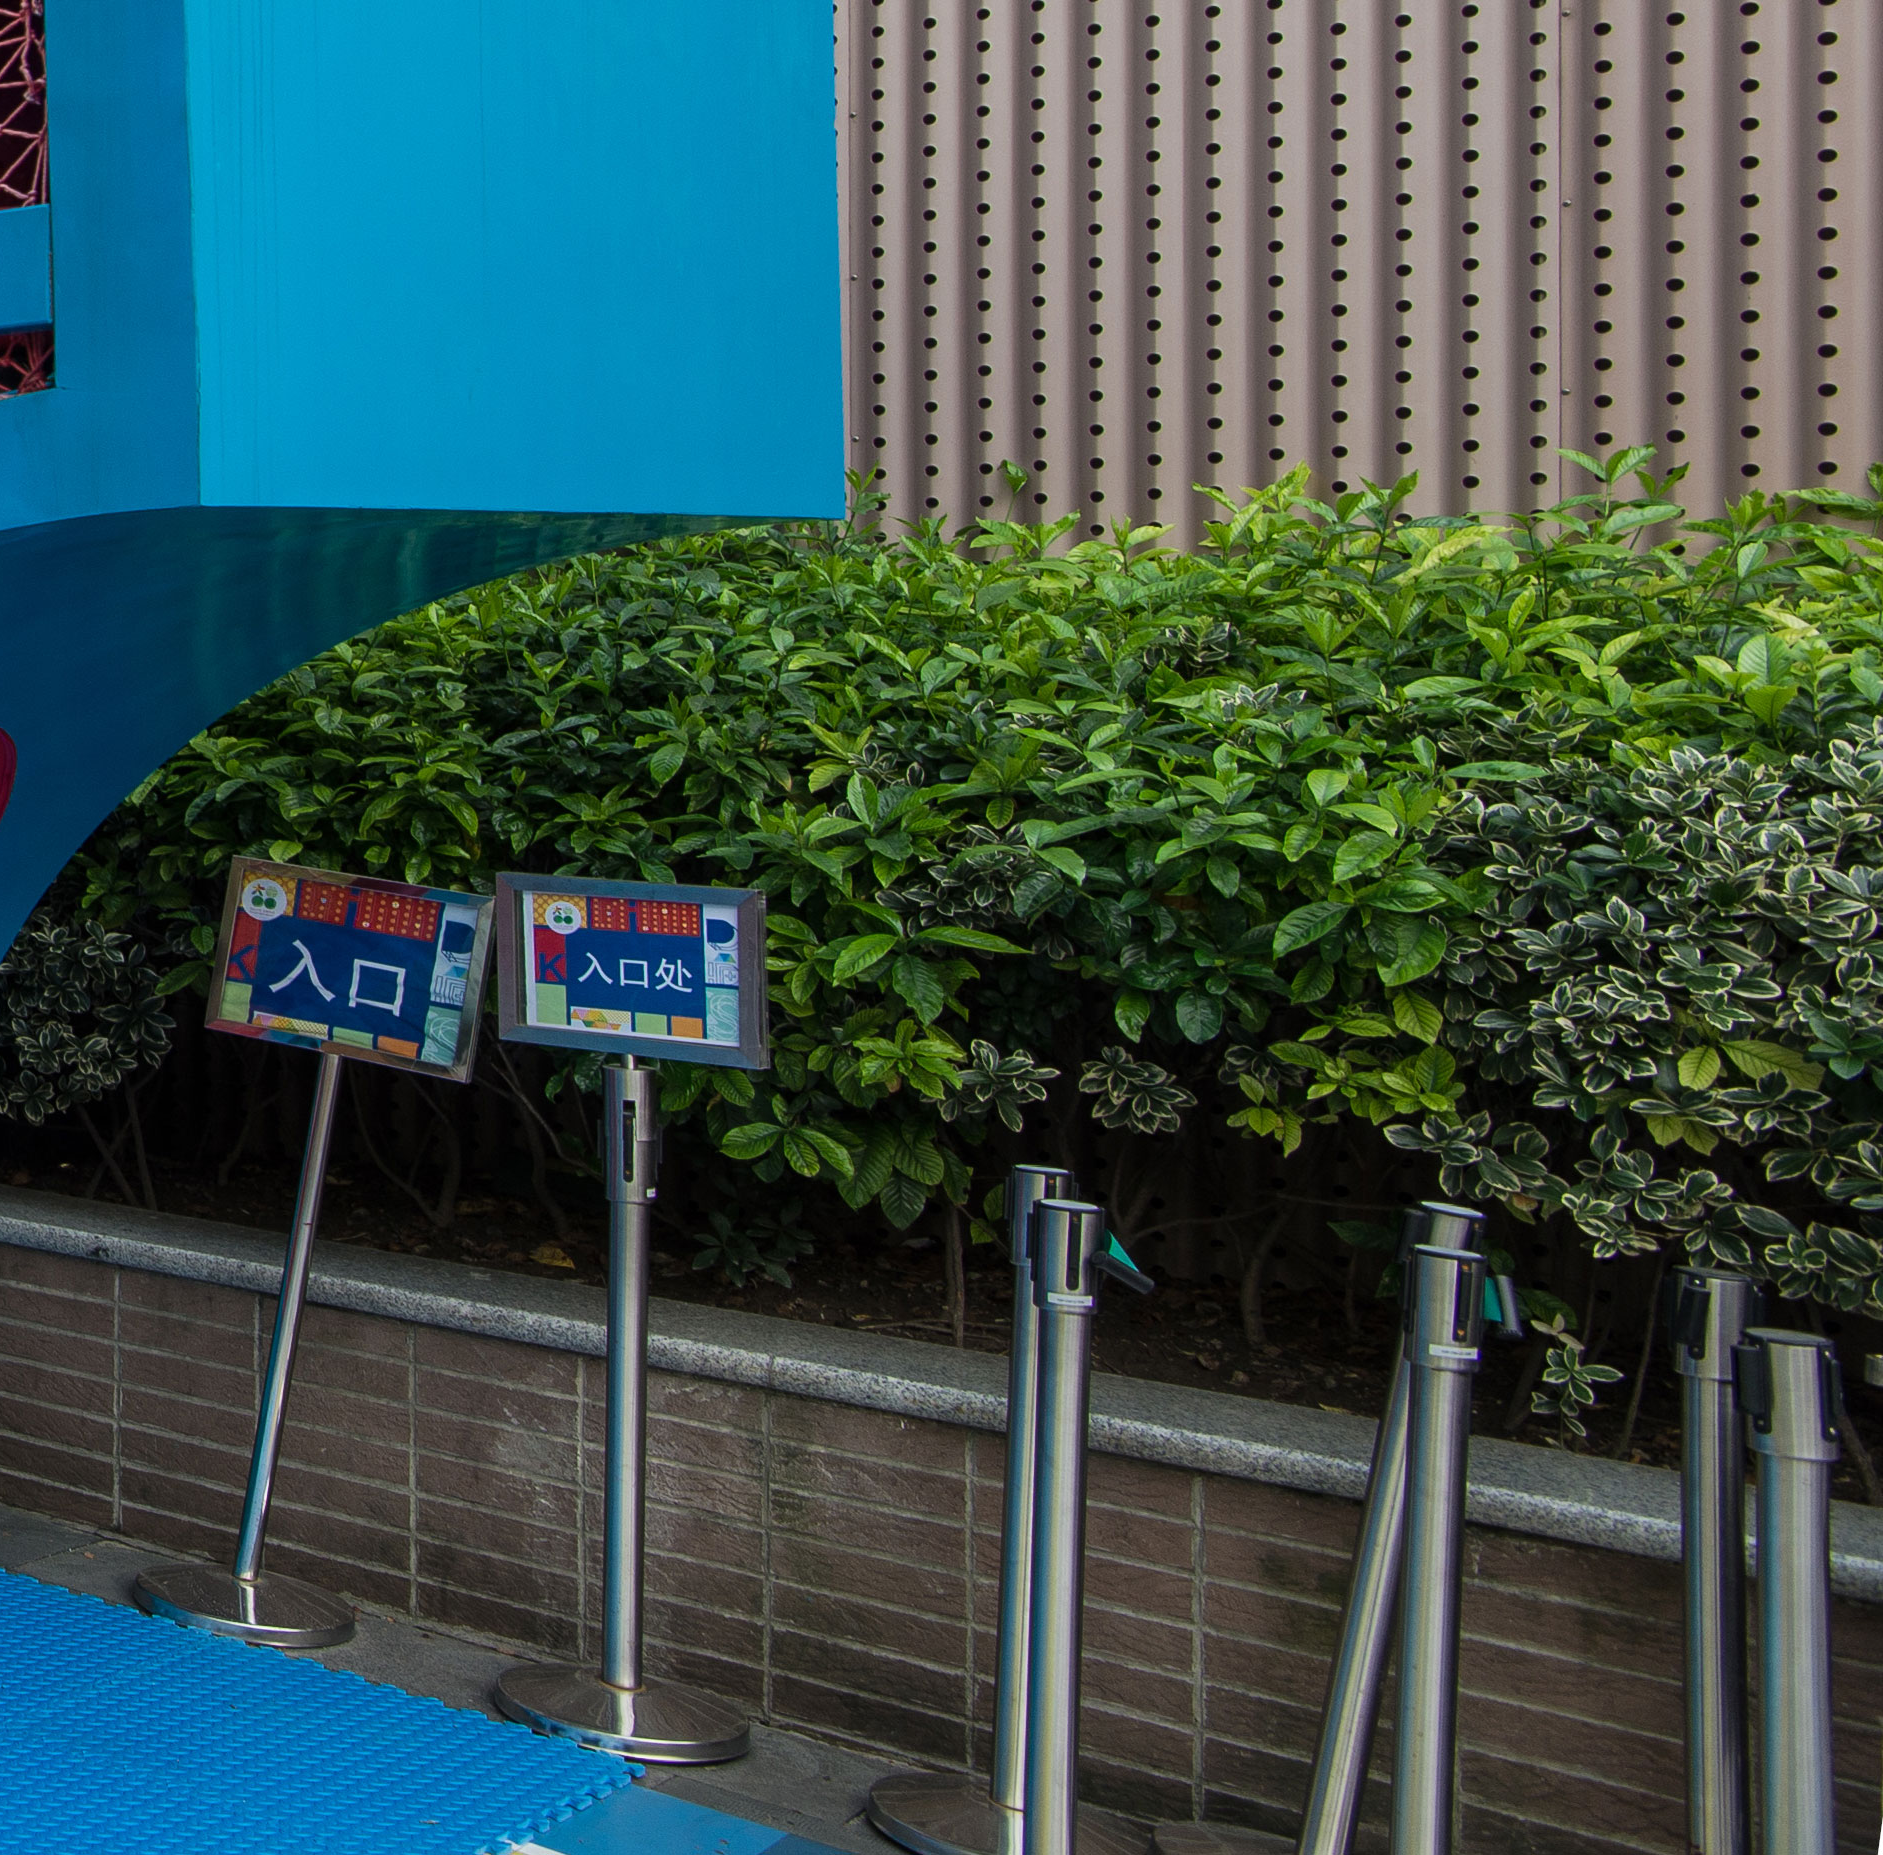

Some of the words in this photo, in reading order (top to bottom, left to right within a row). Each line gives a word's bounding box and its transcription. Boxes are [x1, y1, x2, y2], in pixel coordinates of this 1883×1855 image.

[268, 939, 406, 1017] 入口
[577, 951, 693, 993] 入口处
